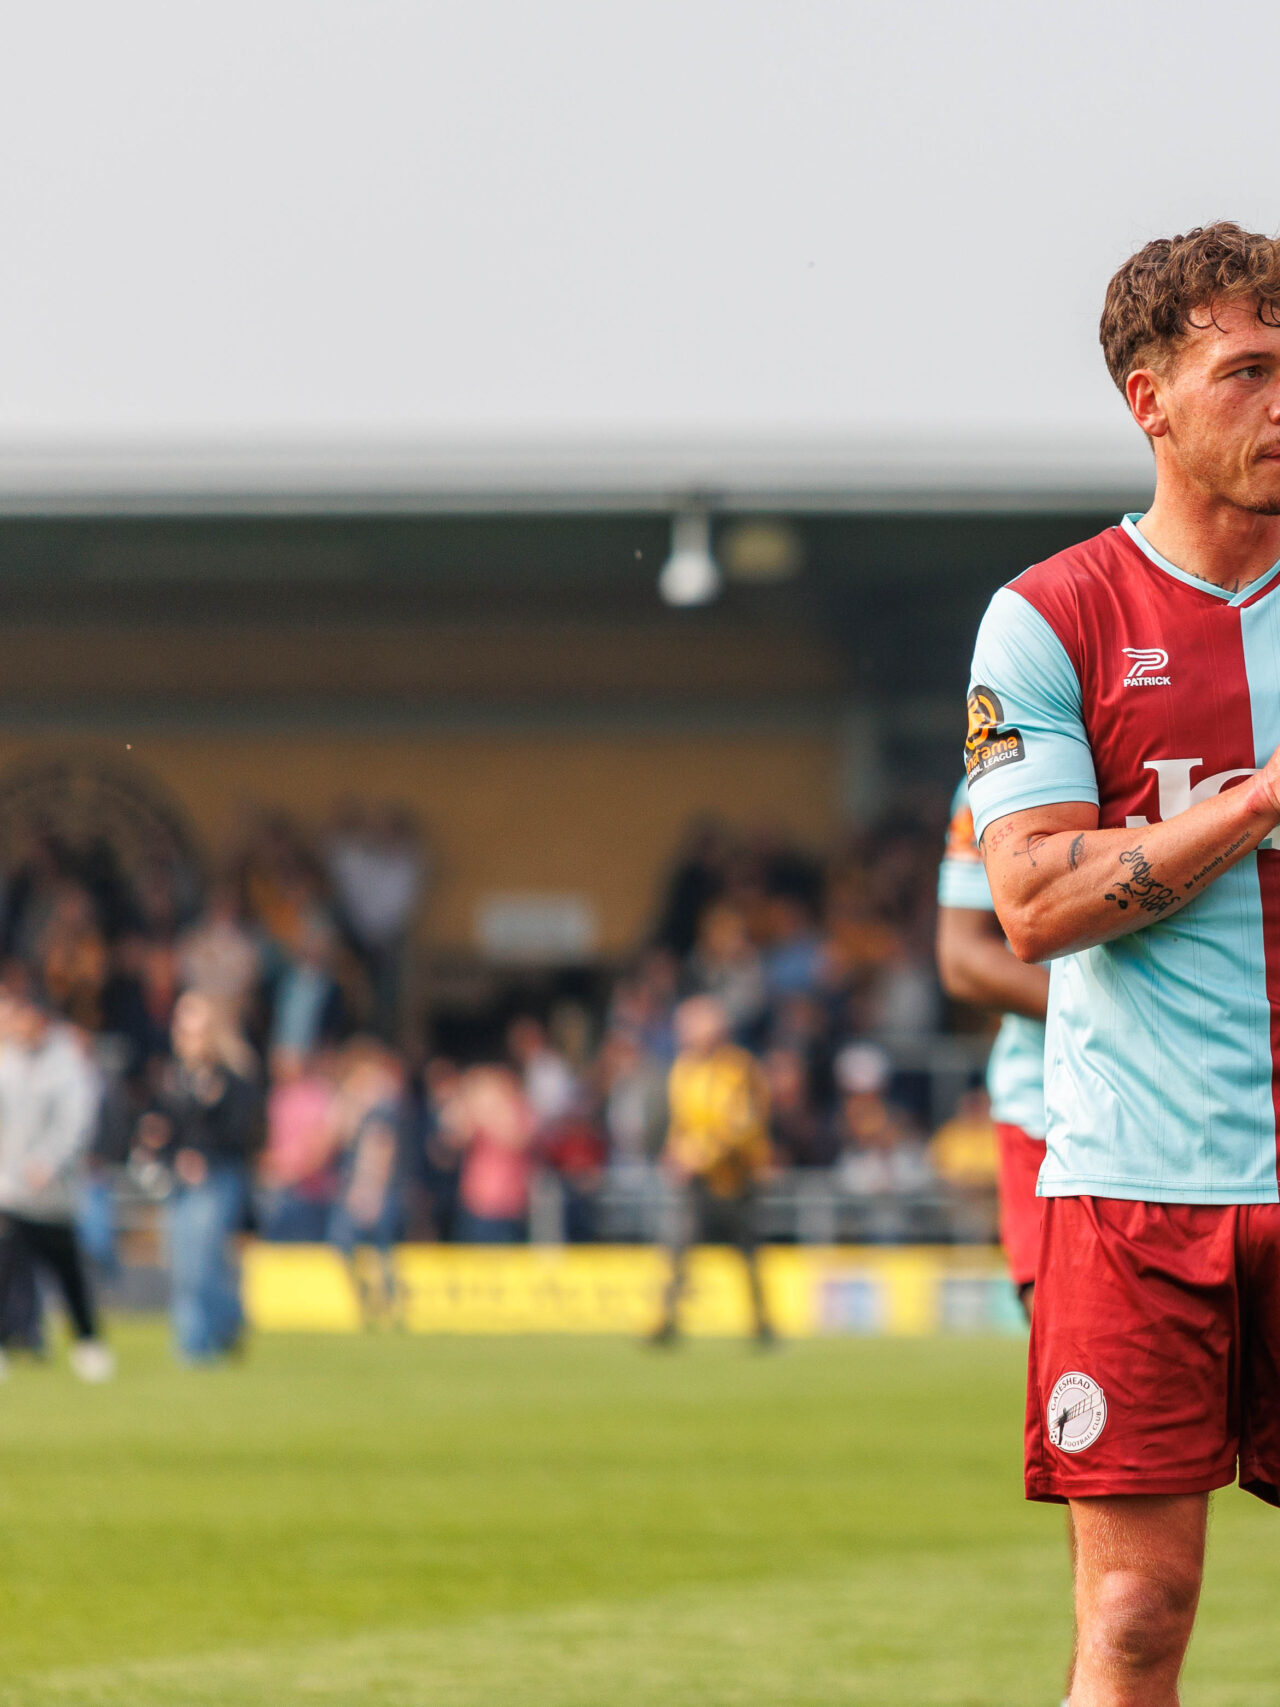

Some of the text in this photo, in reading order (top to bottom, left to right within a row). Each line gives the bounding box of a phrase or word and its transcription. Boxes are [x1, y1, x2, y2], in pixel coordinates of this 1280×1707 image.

[1122, 676, 1172, 688] PATRICK
[983, 748, 1019, 769] LEAGUE
[1051, 1376, 1091, 1411] GATESHEAD
[1063, 1411, 1102, 1447] FOOTBALL CLUB
